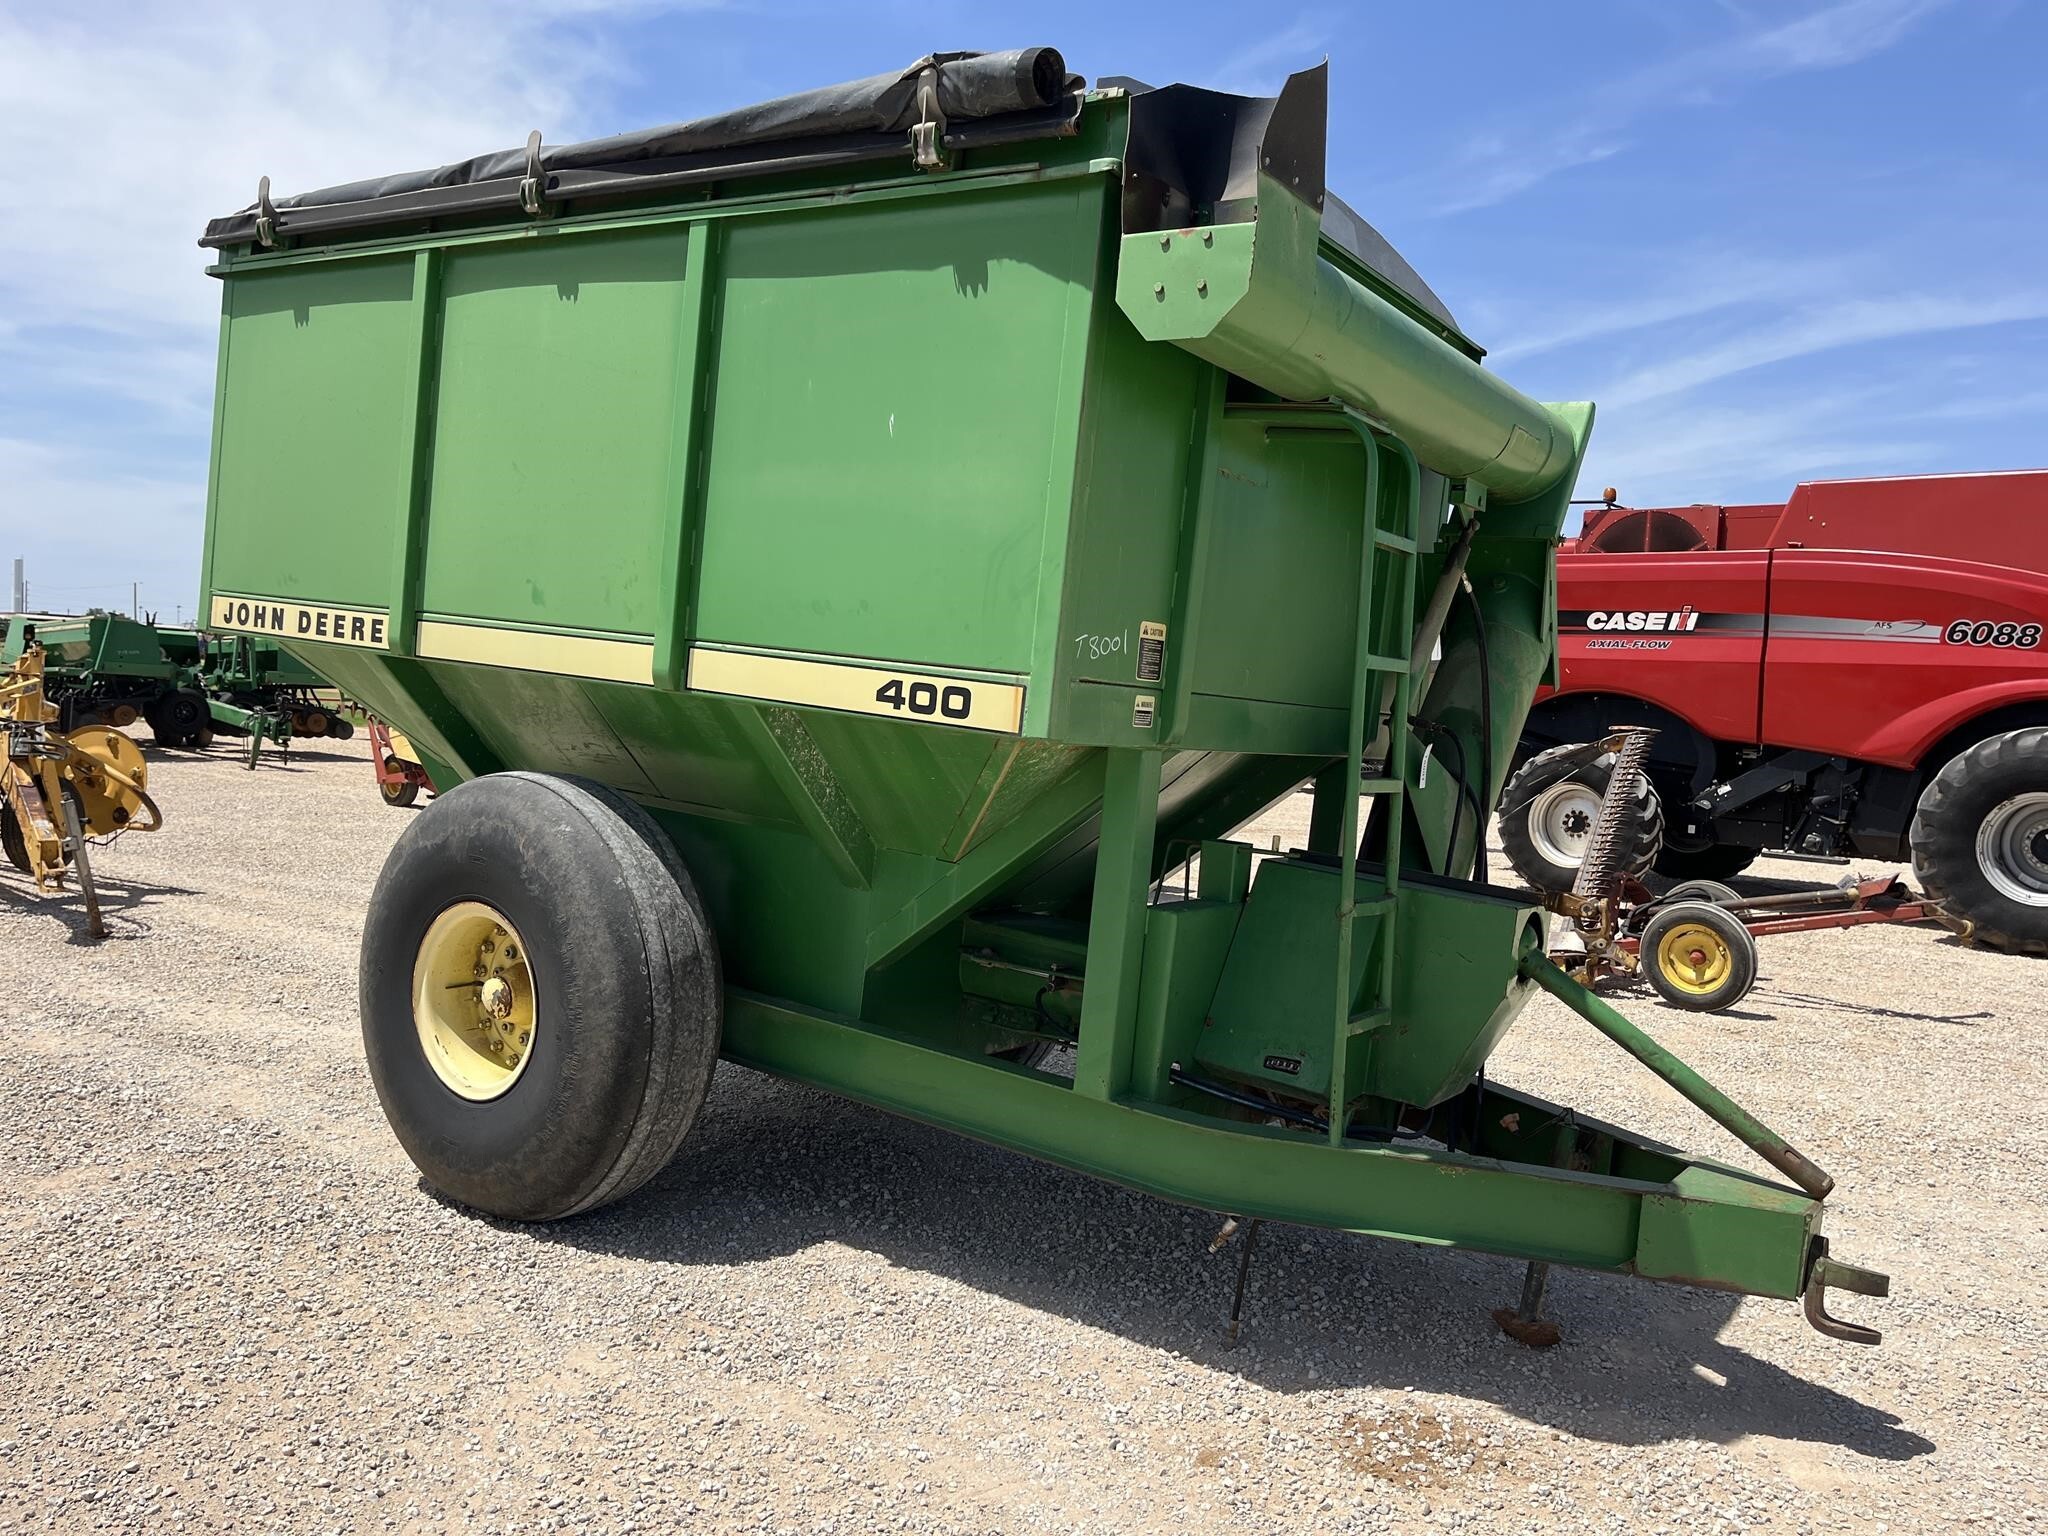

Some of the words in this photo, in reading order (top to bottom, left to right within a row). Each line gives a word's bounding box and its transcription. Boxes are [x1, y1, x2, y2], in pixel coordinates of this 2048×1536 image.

[223, 602, 284, 630] JOHN
[298, 610, 383, 643] DEERE
[1586, 611, 1668, 631] CASE
[1946, 619, 2042, 649] 6088
[1075, 629, 1127, 659] T8001
[1586, 640, 1672, 650] AXIAL-FLOW
[875, 679, 972, 720] 400
